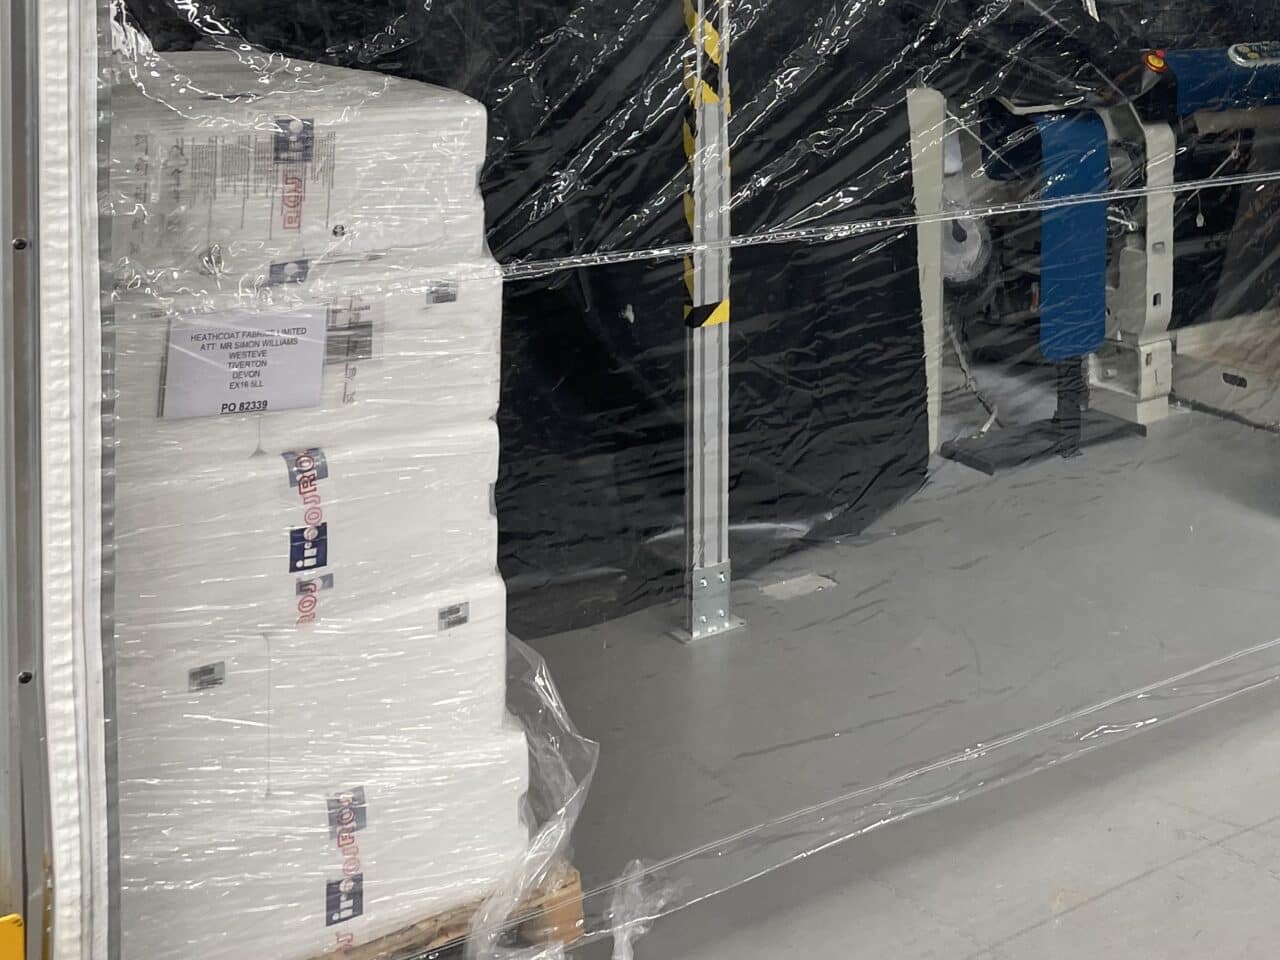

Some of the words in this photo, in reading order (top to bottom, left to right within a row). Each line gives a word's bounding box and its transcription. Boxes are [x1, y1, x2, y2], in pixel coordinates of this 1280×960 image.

[191, 331, 240, 341] HEATHCOAT
[241, 329, 276, 339] FABR
[220, 342, 232, 350] MR
[234, 340, 260, 349] SIMON
[262, 338, 299, 347] WILLIAMS
[229, 350, 267, 359] WESTEVE
[228, 360, 267, 369] TIVERTON
[232, 370, 260, 379] DEVON
[221, 402, 236, 412] PO
[238, 400, 268, 411] 82339
